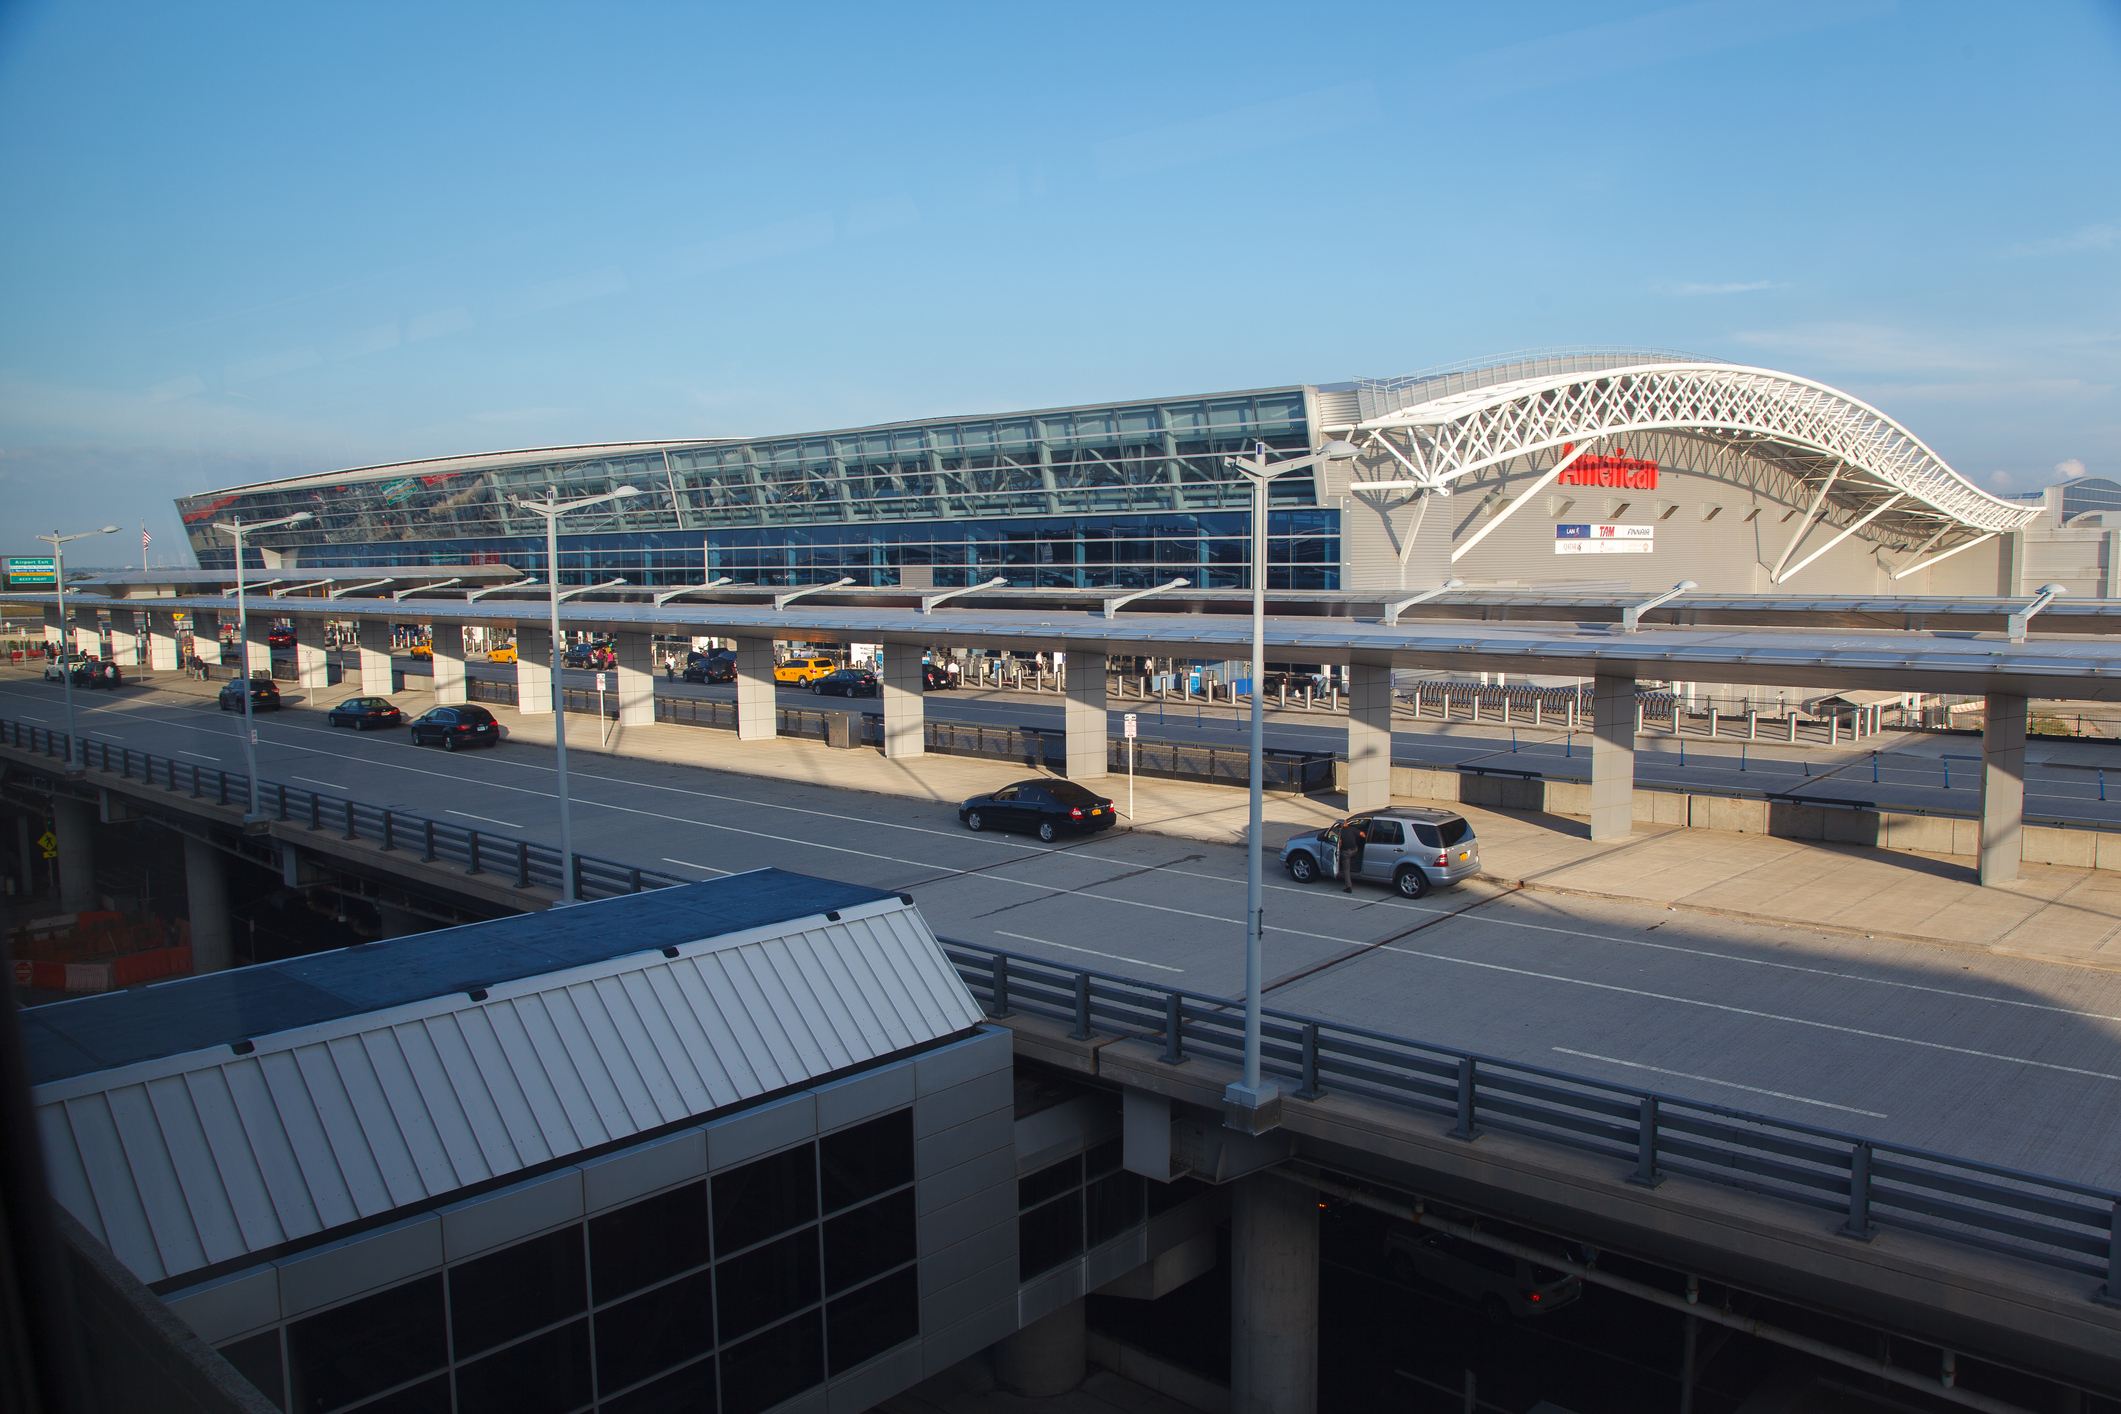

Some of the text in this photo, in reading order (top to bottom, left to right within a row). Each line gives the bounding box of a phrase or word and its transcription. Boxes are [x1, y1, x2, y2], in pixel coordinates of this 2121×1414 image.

[1557, 442, 1659, 490] American
[1599, 526, 1615, 537] TAM
[1627, 528, 1650, 536] FINNAIR
